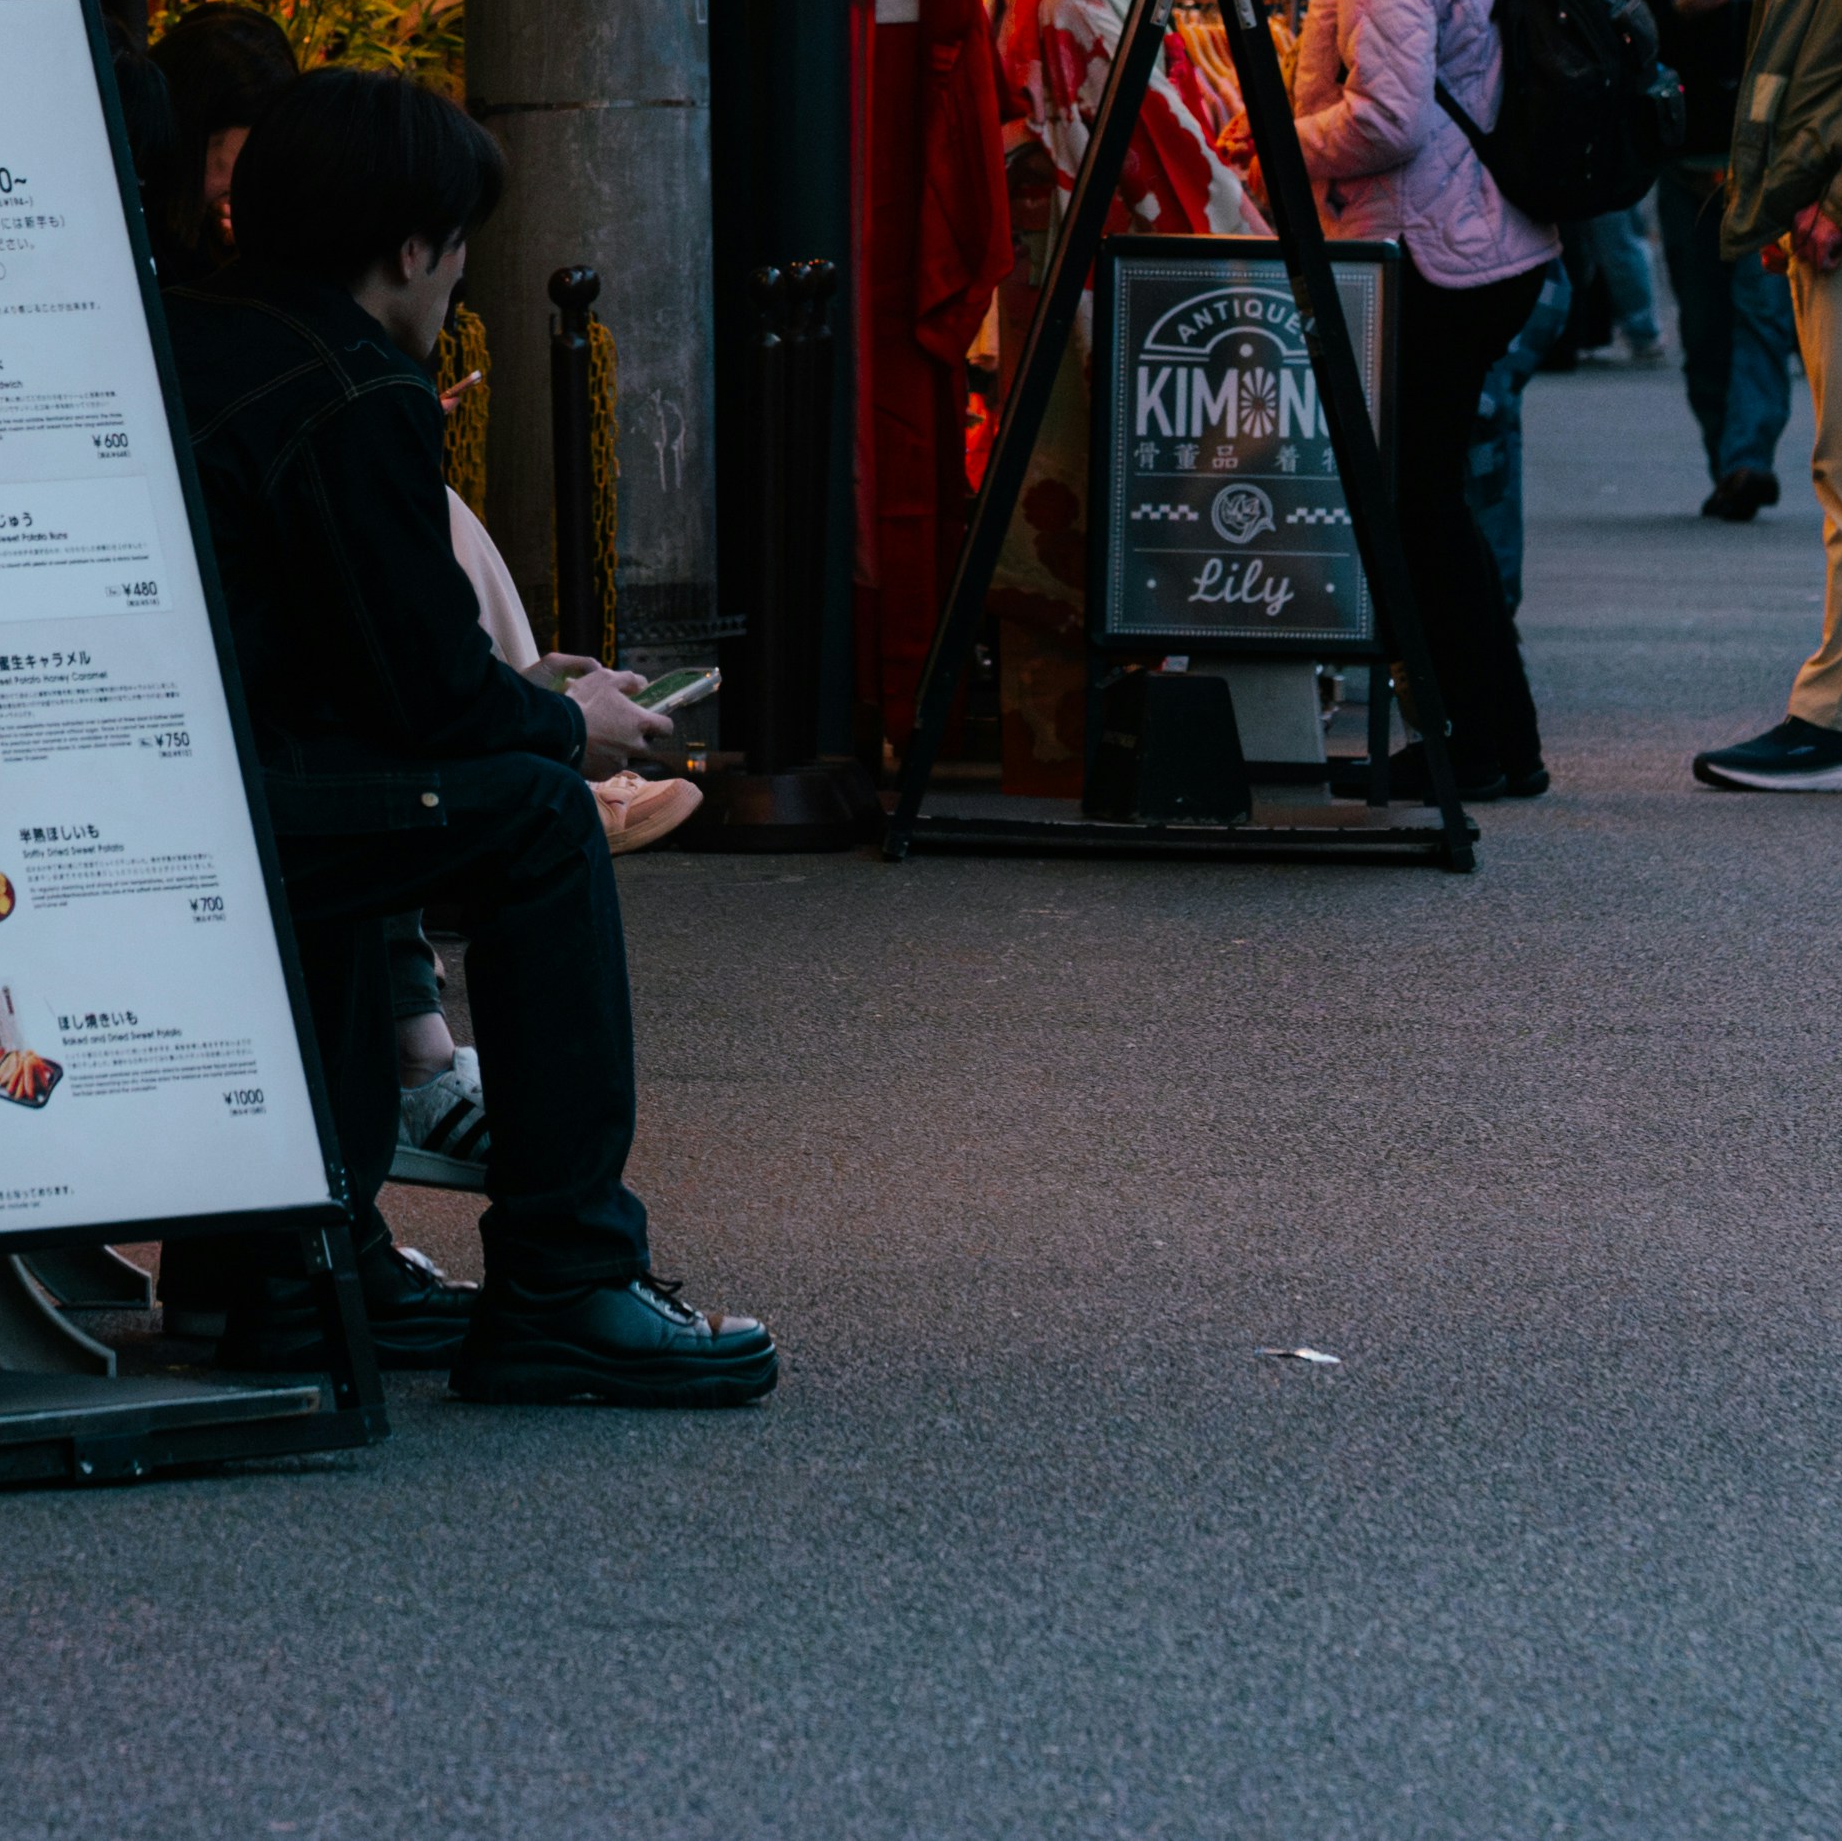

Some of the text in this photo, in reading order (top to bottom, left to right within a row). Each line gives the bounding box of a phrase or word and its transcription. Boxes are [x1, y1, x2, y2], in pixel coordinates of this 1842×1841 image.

[1135, 365, 1330, 439] KIMON
[92, 432, 129, 449] ¥600
[1133, 442, 1238, 472] 骨董品
[122, 580, 158, 596] ¥480
[1187, 557, 1295, 616] Lily
[71, 670, 108, 682] Caramel
[154, 731, 191, 749] ¥750
[18, 823, 100, 844] 半熟ほしいも
[189, 895, 225, 912] ¥700
[57, 1009, 139, 1031] ほし焼きいも
[222, 1088, 265, 1106] ¥1000
